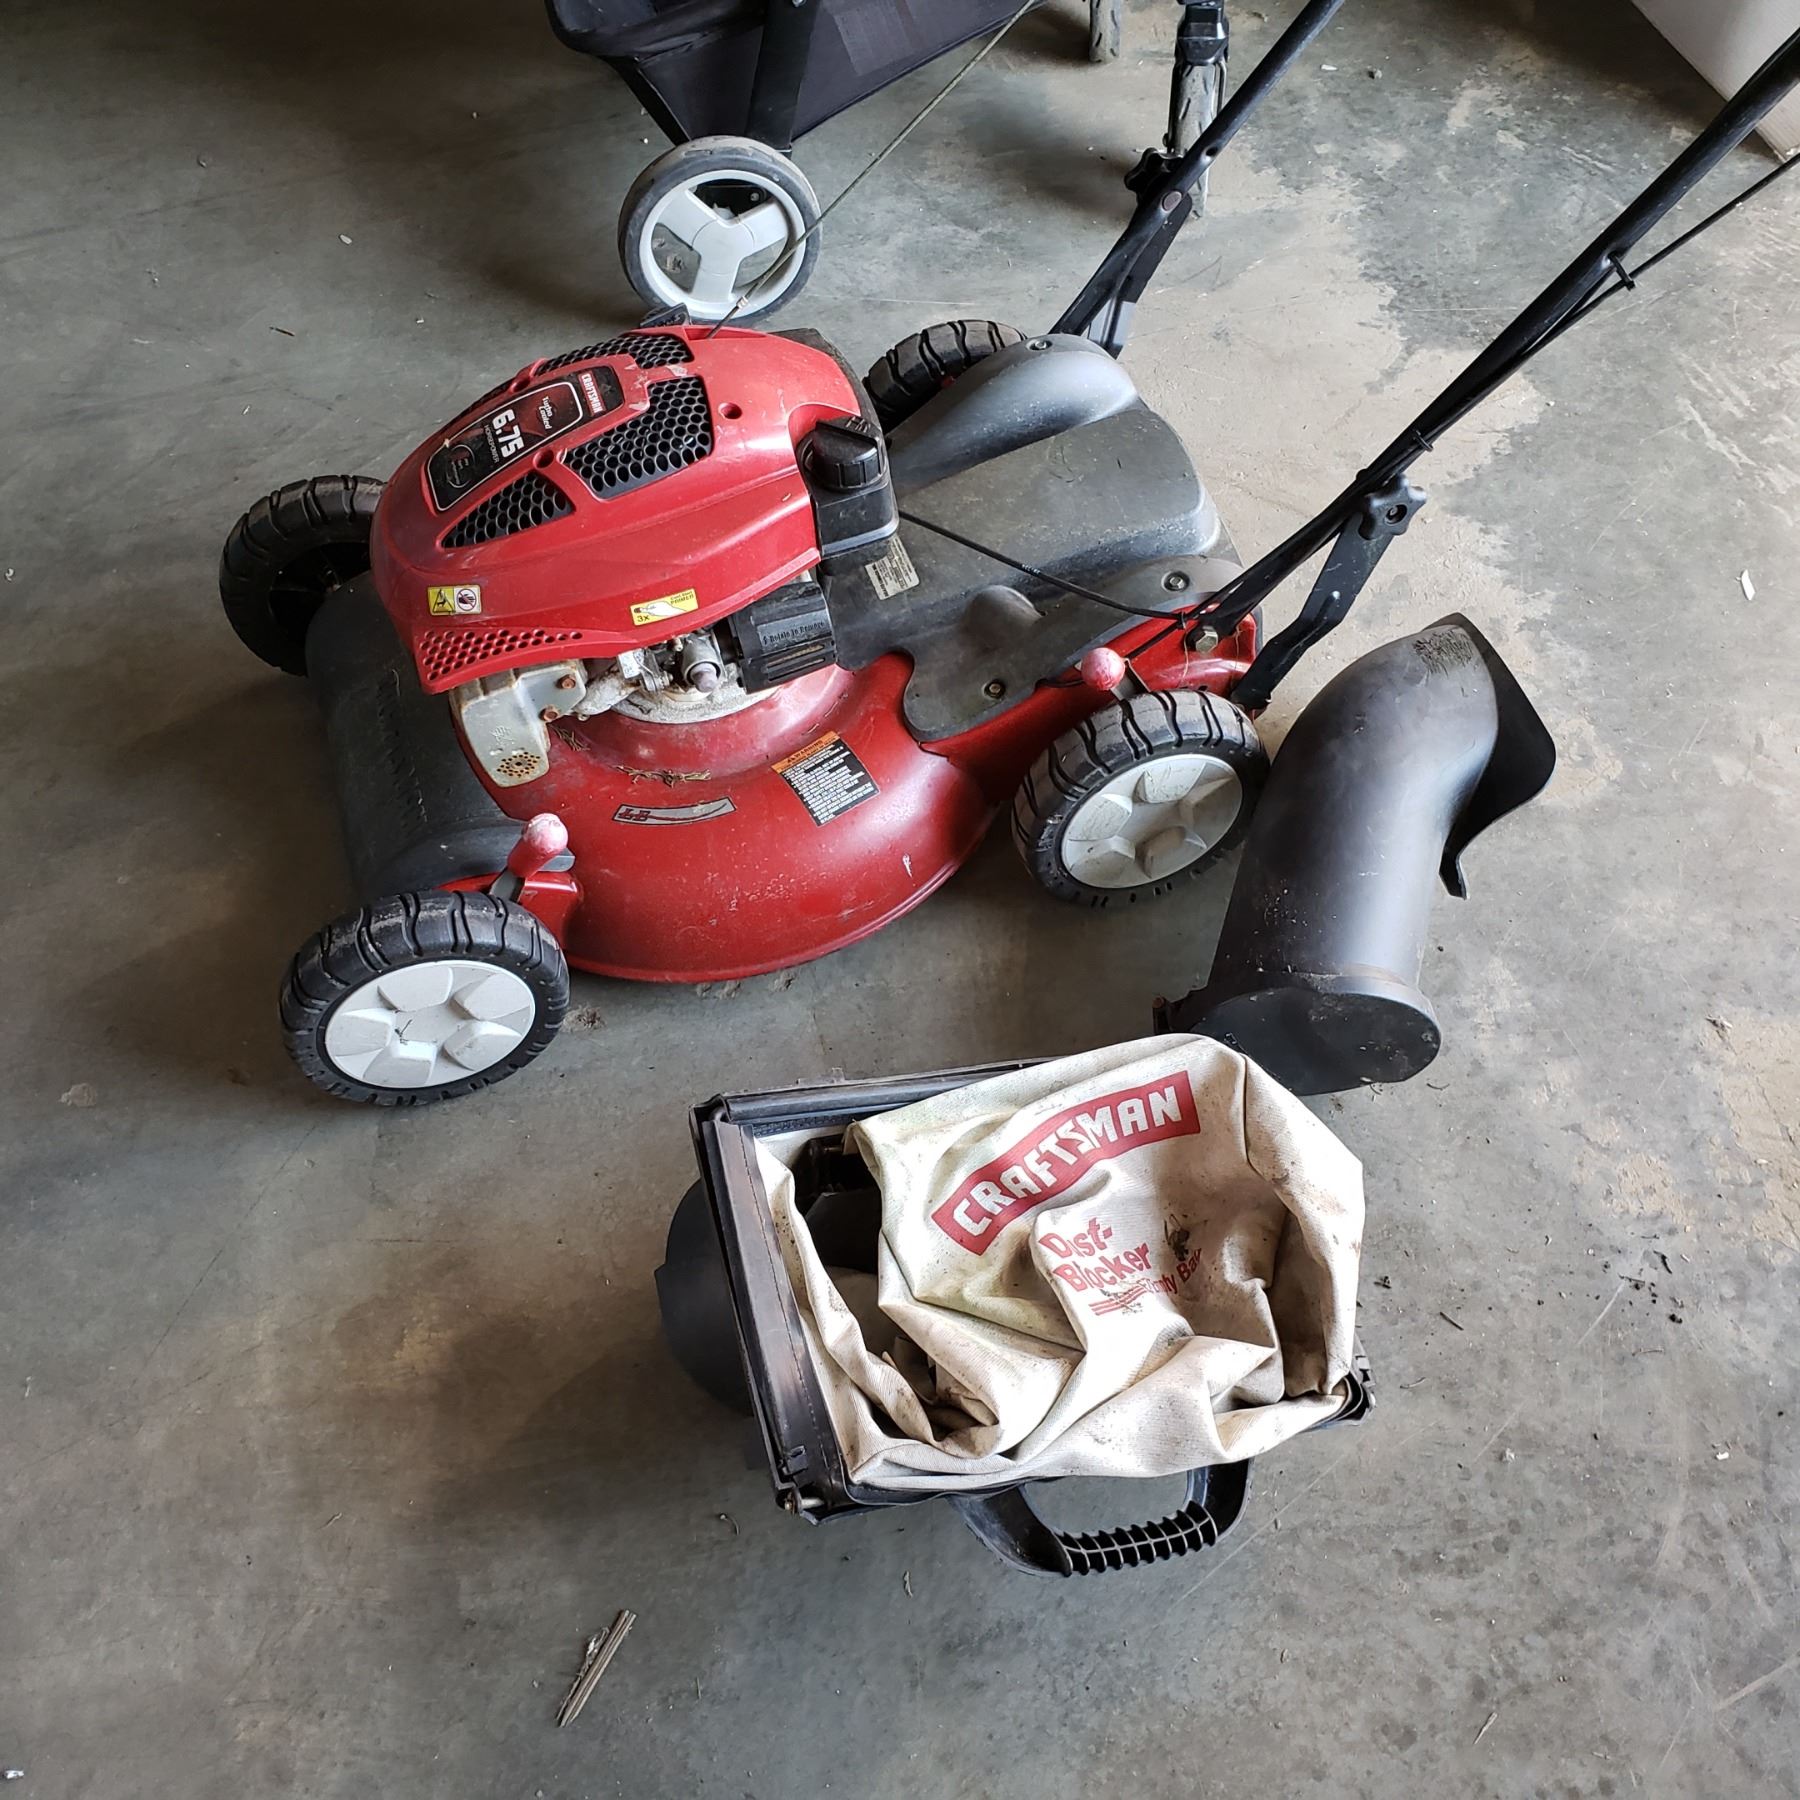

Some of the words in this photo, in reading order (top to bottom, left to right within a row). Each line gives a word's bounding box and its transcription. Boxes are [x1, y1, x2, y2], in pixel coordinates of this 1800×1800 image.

[542, 395, 553, 417] Turbo
[581, 373, 603, 413] CRAFTSMAN
[492, 408, 525, 458] 6.75
[538, 405, 552, 430] Cooled
[484, 424, 500, 463] HORSEPOWER
[953, 1085, 1183, 1237] CRAFTSMAN
[1052, 1242, 1152, 1292] Blocker
